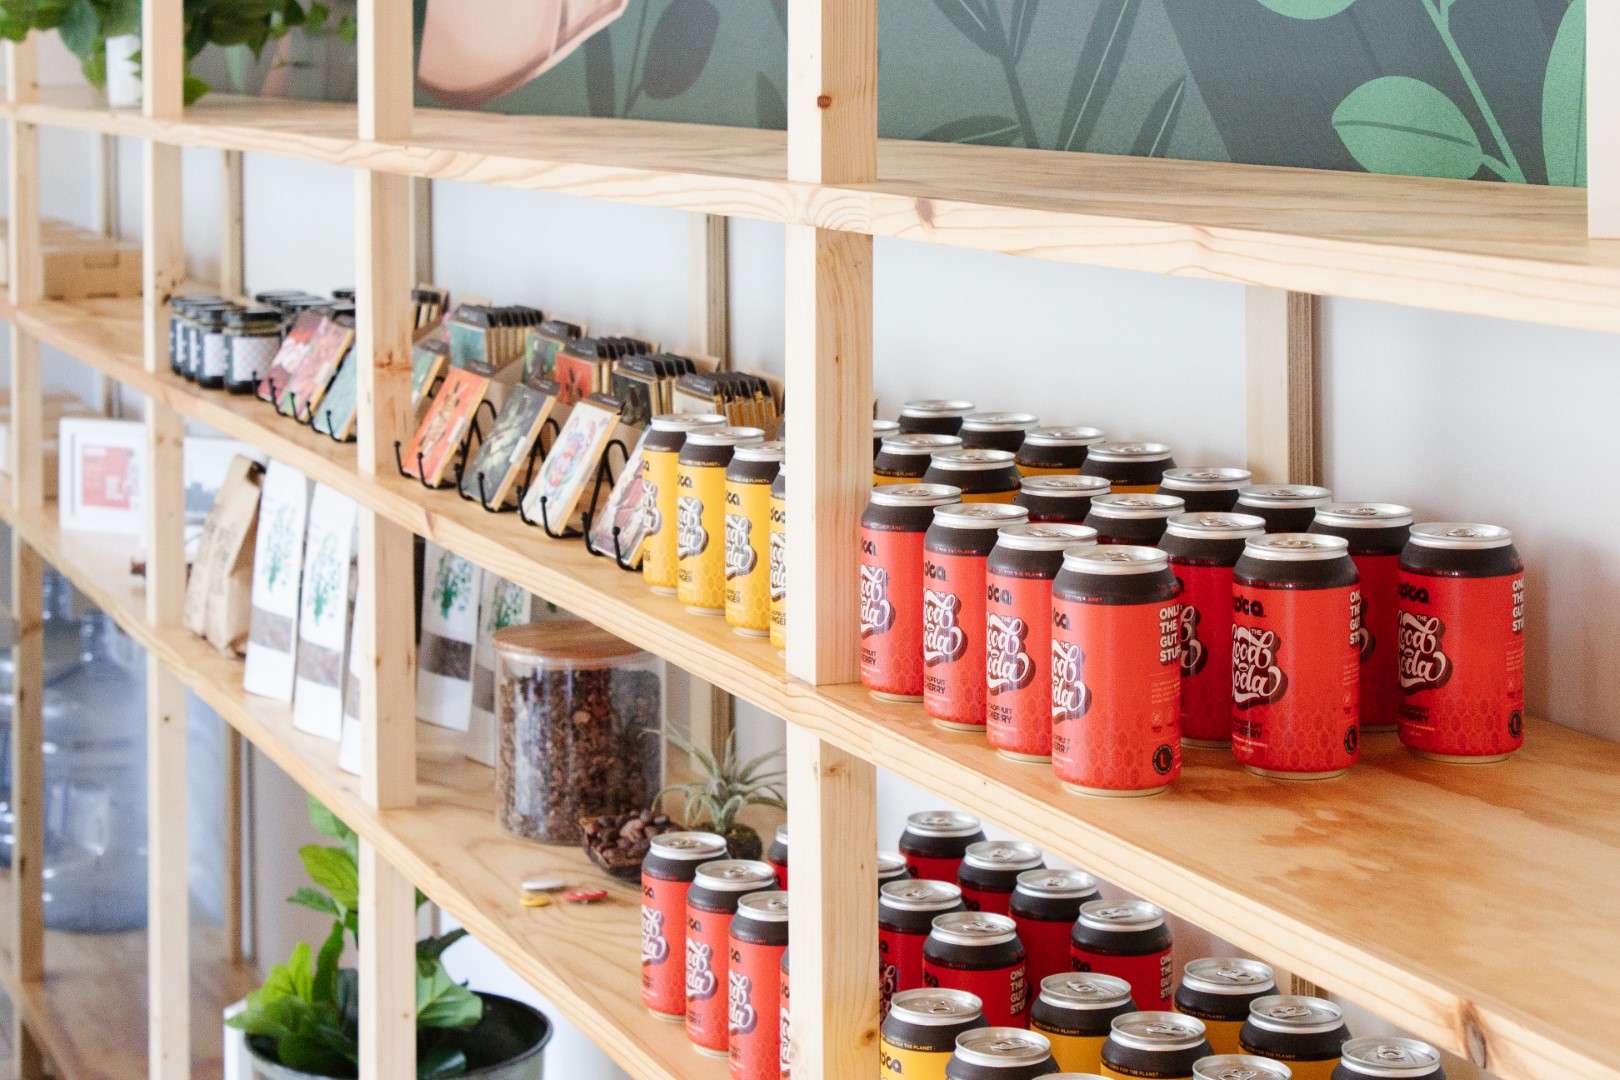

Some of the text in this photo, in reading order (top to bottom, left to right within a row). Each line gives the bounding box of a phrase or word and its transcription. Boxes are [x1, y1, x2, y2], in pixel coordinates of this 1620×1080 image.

[1416, 614, 1428, 622] THE
[1159, 619, 1178, 634] THE
[1250, 628, 1263, 636] THE
[1160, 633, 1178, 648] GUT
[1139, 1070, 1159, 1078] PLANET
